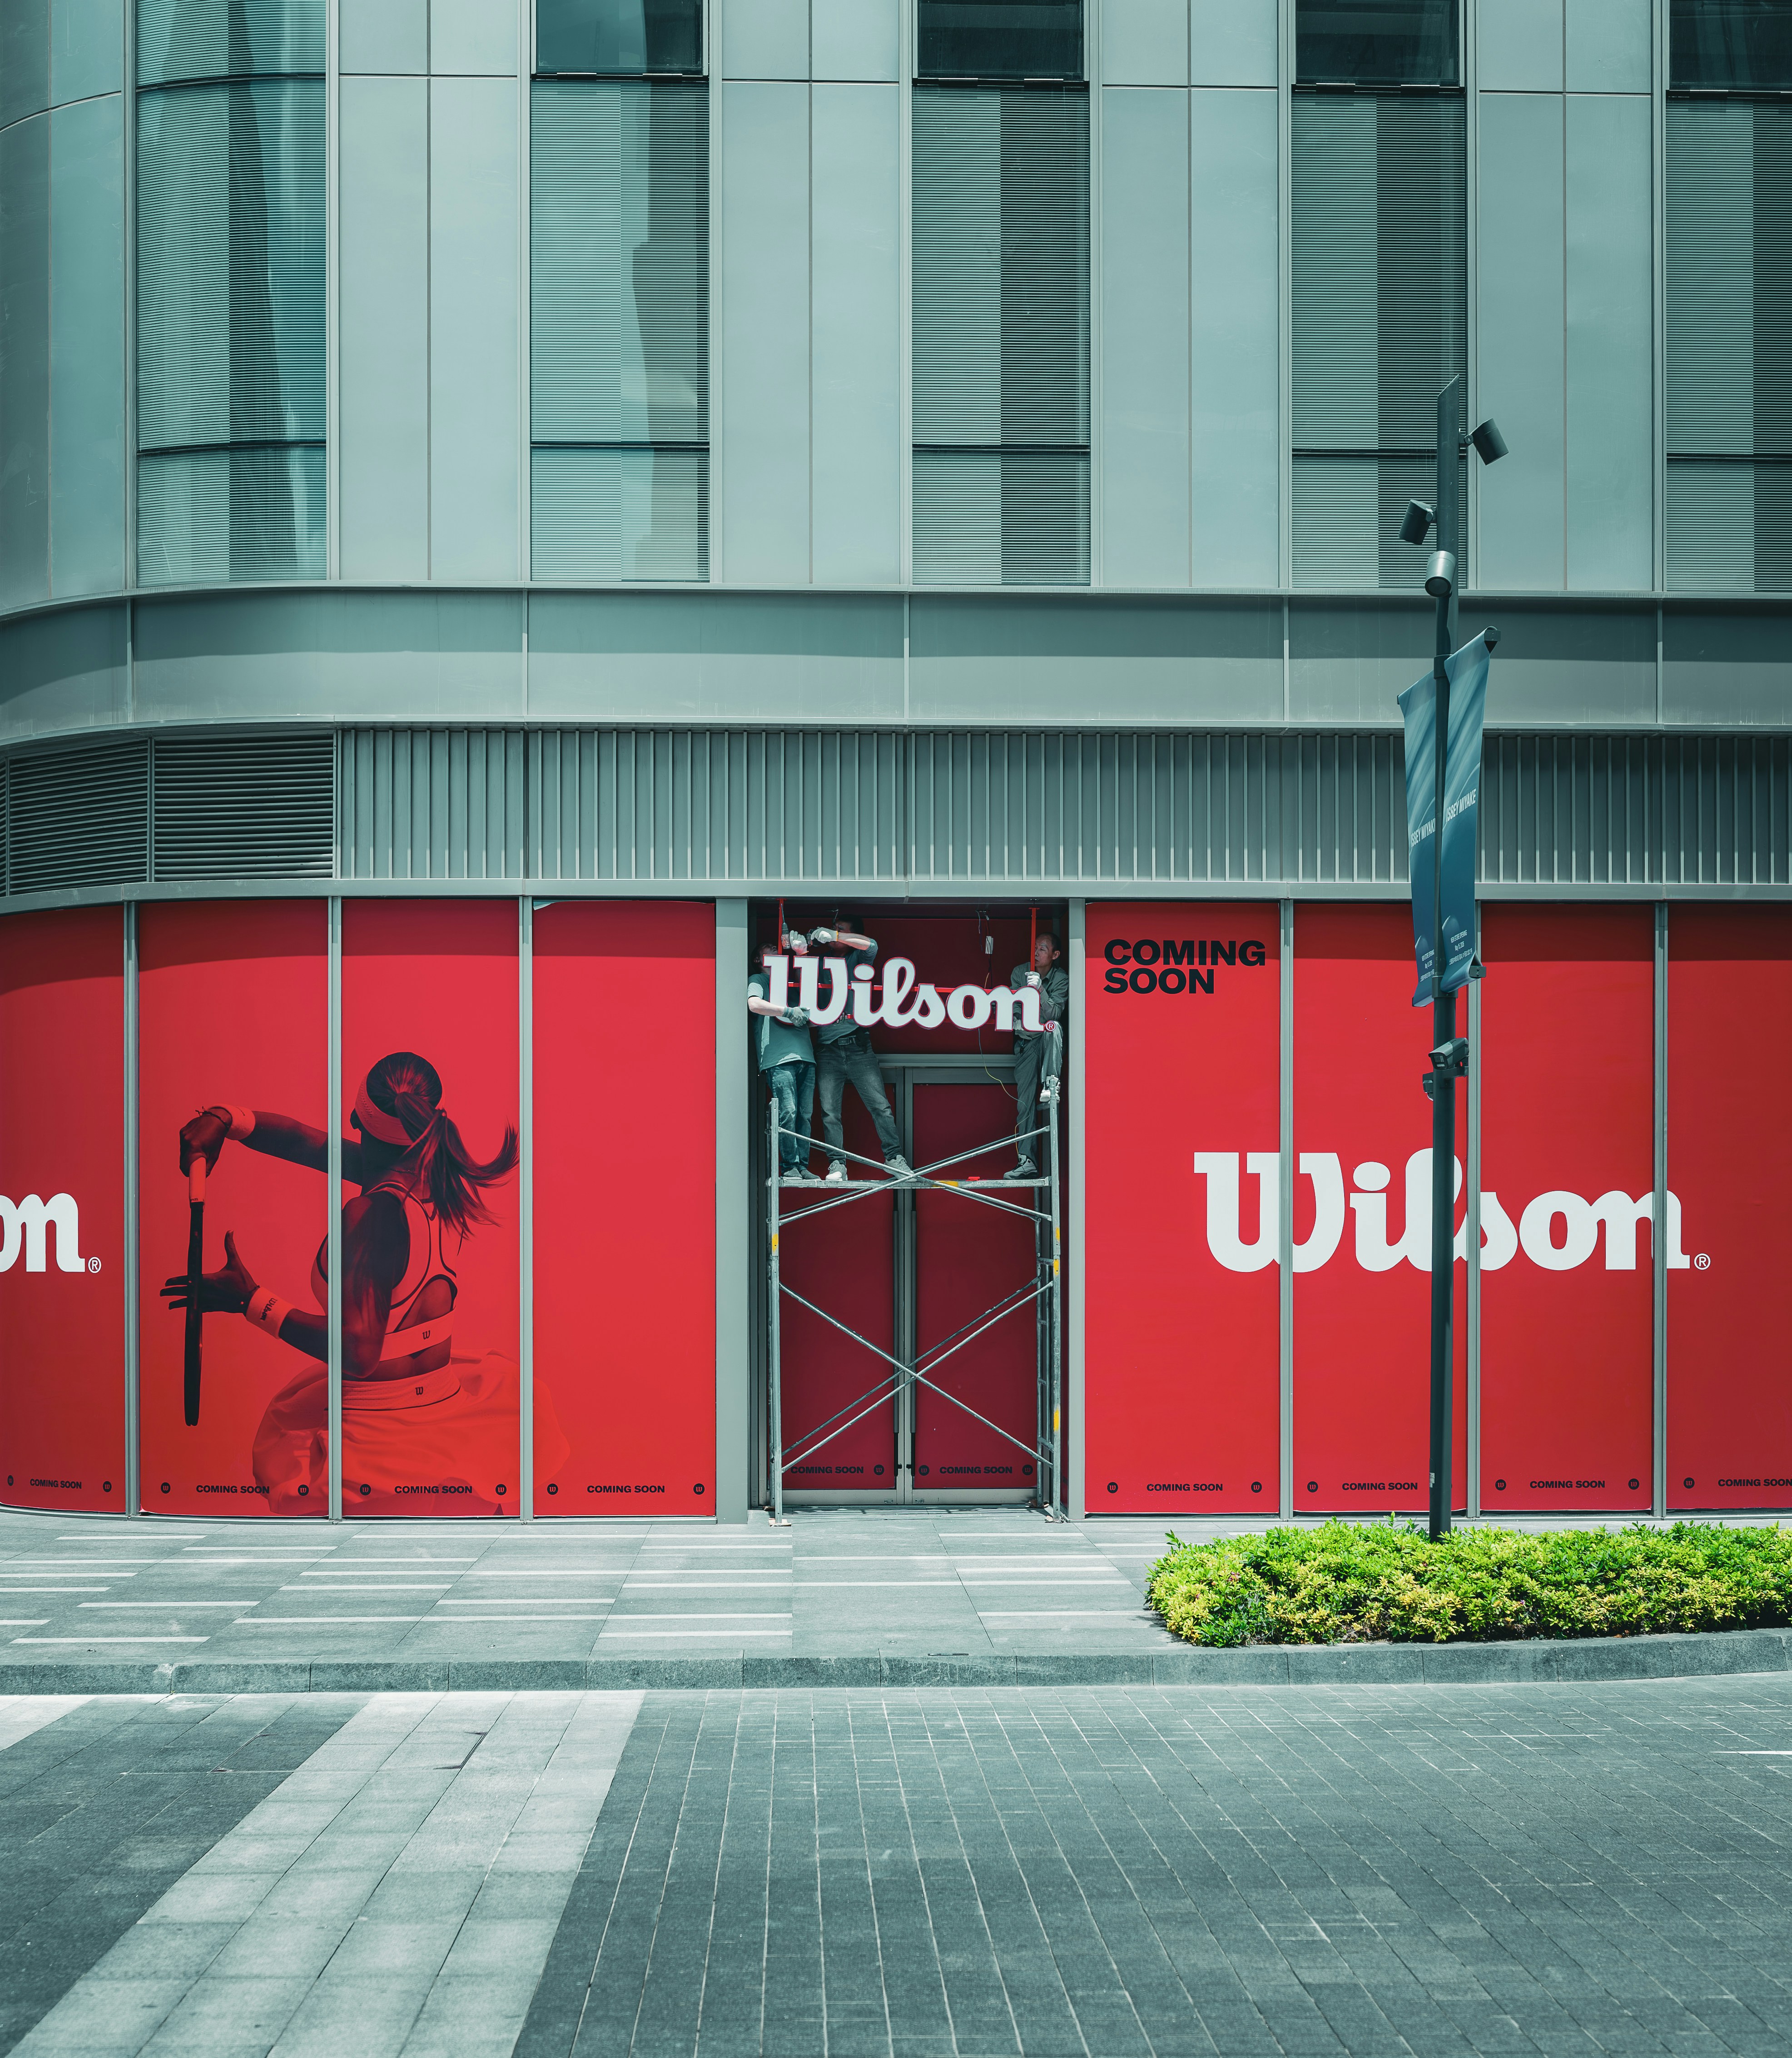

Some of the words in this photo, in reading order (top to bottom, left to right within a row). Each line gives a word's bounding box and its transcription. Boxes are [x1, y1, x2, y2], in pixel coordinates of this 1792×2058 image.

[1446, 800, 1459, 823] ISSEY
[1459, 788, 1476, 814] MIYAKE
[1410, 827, 1421, 848] ISSEY
[1104, 939, 1266, 966] COMING
[1103, 967, 1214, 994] SOON
[30, 1478, 59, 1488] COMING
[60, 1480, 82, 1489] SOON
[1147, 1483, 1191, 1491] COMING
[1193, 1483, 1223, 1491] SOON
[1342, 1482, 1385, 1491] COMING
[1388, 1482, 1418, 1491] SOON
[1529, 1480, 1573, 1489] COMING
[1575, 1480, 1605, 1488] SOON
[1718, 1479, 1761, 1487] COMING
[196, 1485, 238, 1493] COMING
[240, 1485, 270, 1494] SOON
[394, 1486, 439, 1494] COMING
[441, 1486, 472, 1494] SOON
[587, 1485, 631, 1493] COMING
[634, 1485, 665, 1493] SOON
